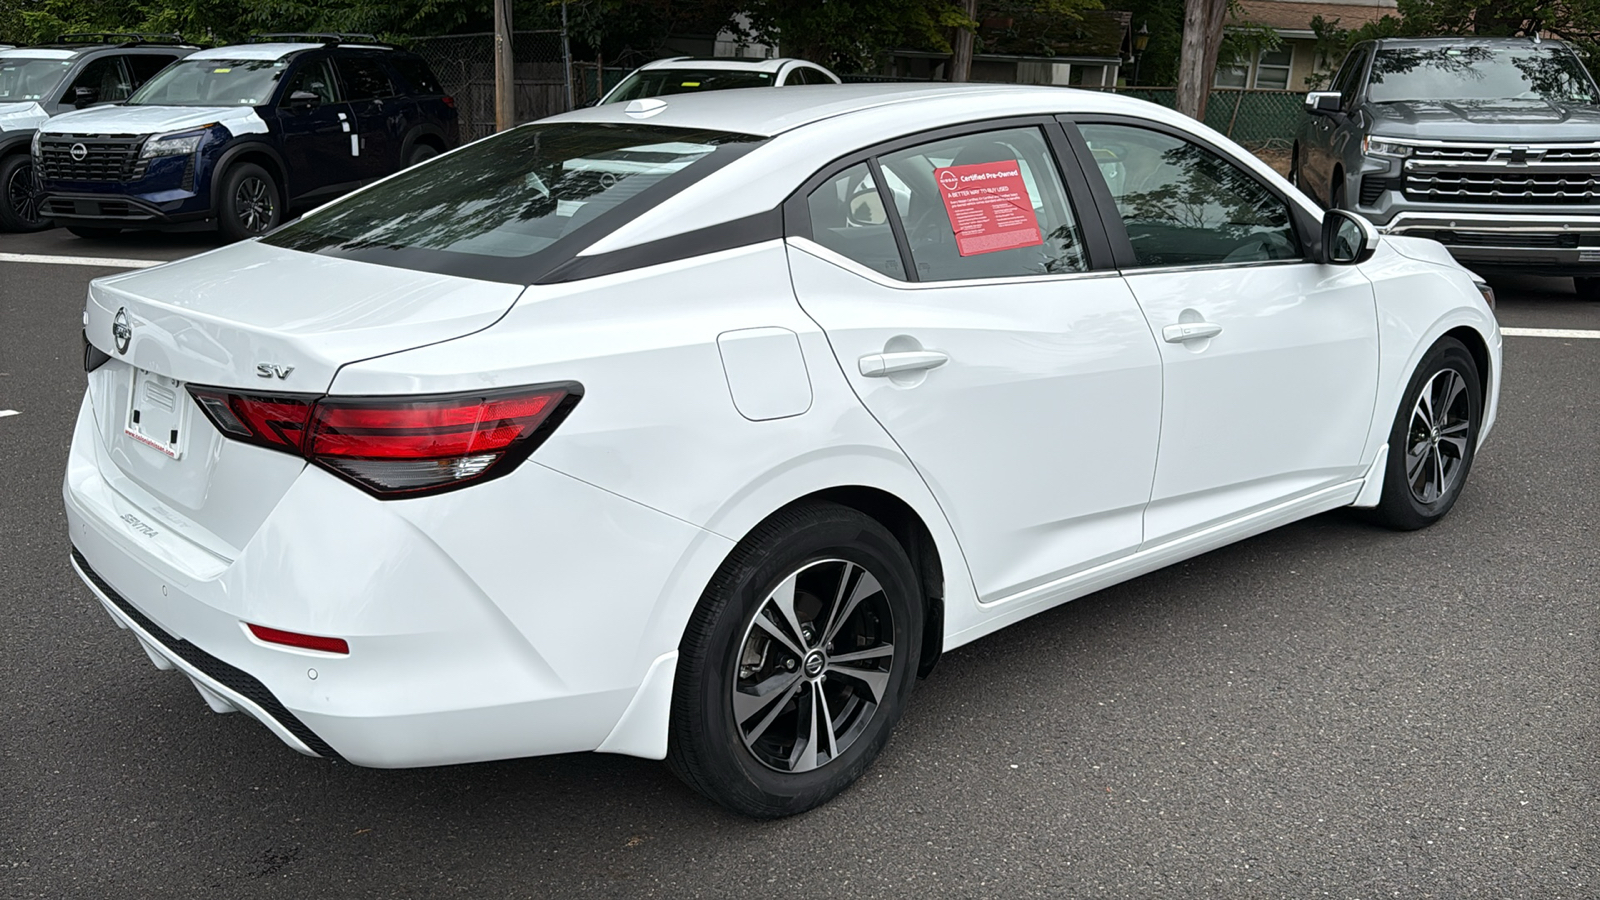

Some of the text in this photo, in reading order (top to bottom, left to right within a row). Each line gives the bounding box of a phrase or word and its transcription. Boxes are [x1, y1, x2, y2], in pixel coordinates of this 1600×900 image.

[960, 169, 1018, 182] Certified Pre-Owned
[257, 363, 295, 380] SV
[120, 513, 159, 538] SENTRA
